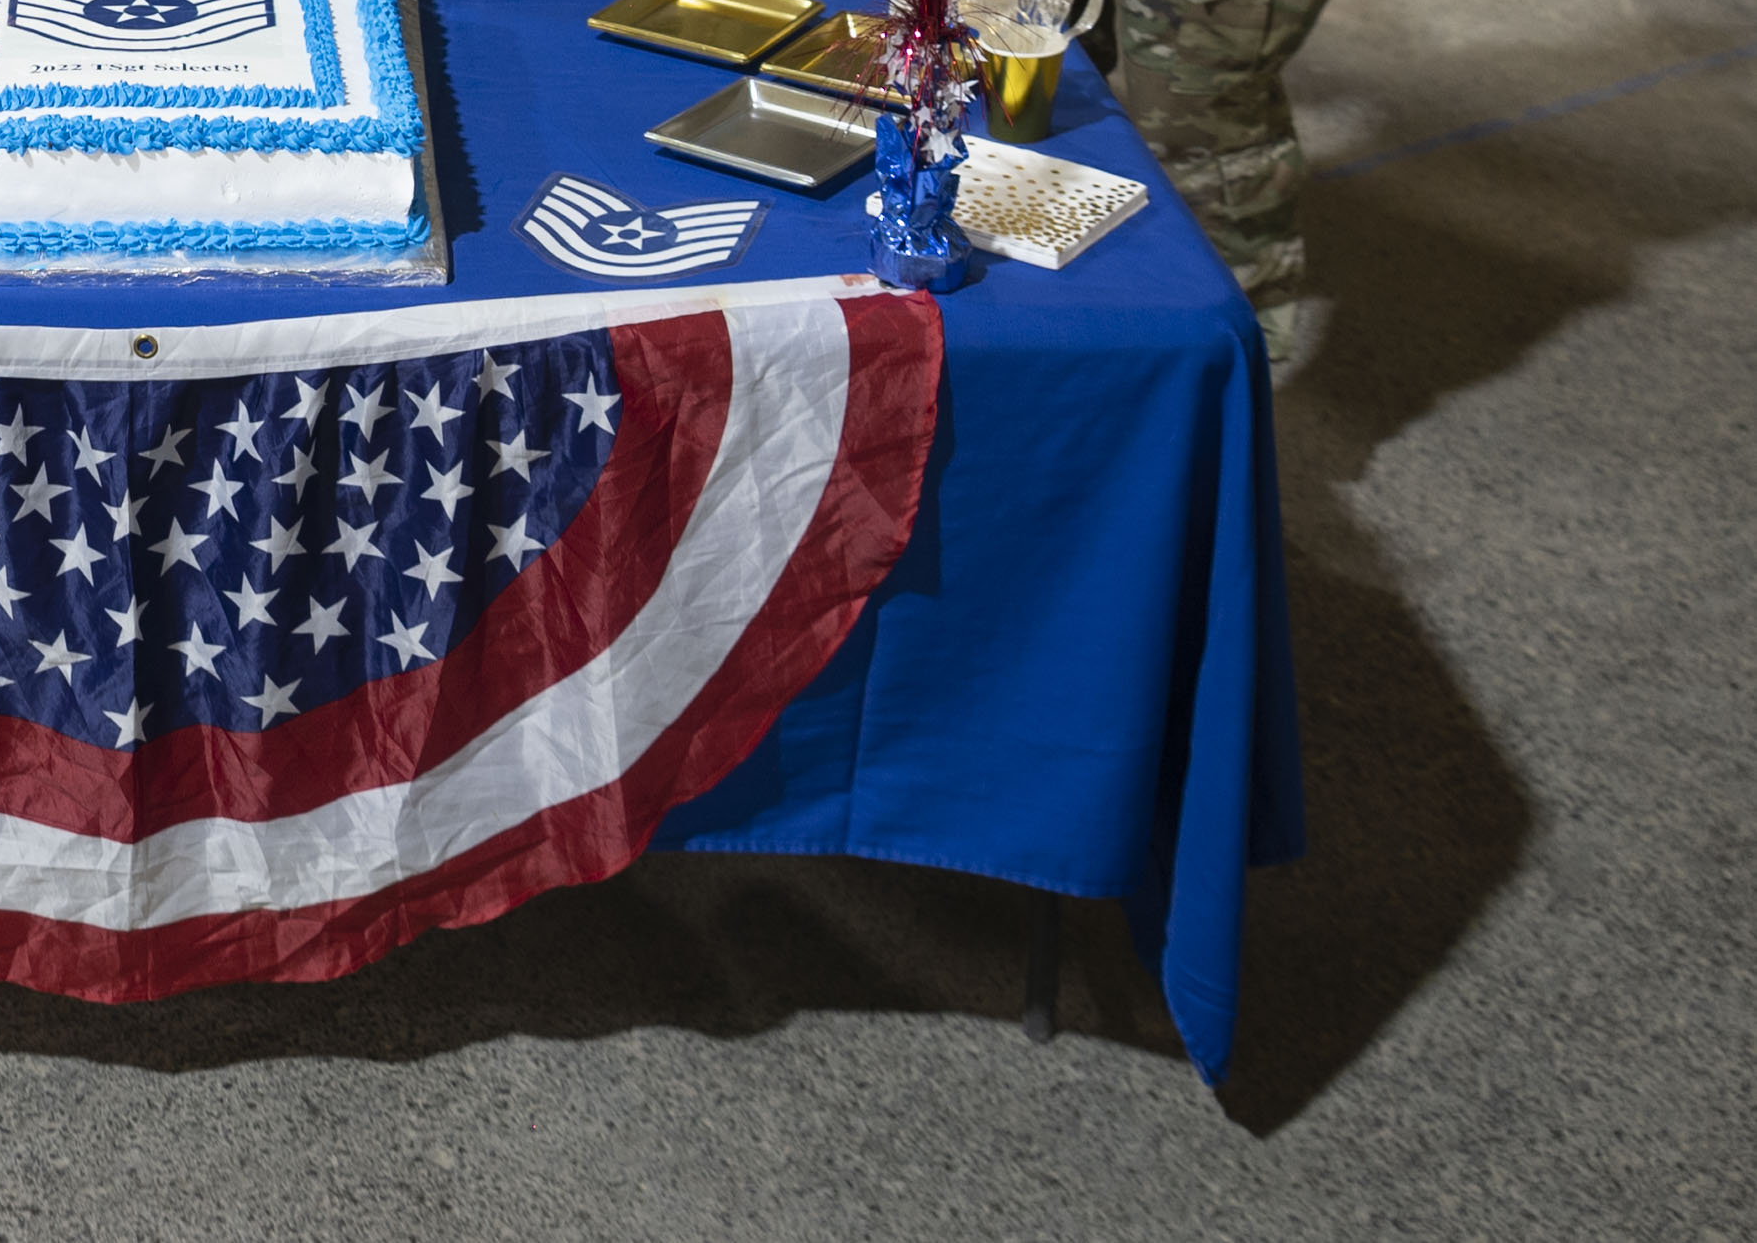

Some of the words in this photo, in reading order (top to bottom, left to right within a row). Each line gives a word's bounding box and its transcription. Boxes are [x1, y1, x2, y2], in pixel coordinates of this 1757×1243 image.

[29, 63, 83, 74] 2022
[91, 62, 146, 73] TSgt
[153, 62, 250, 73] Selects!!
